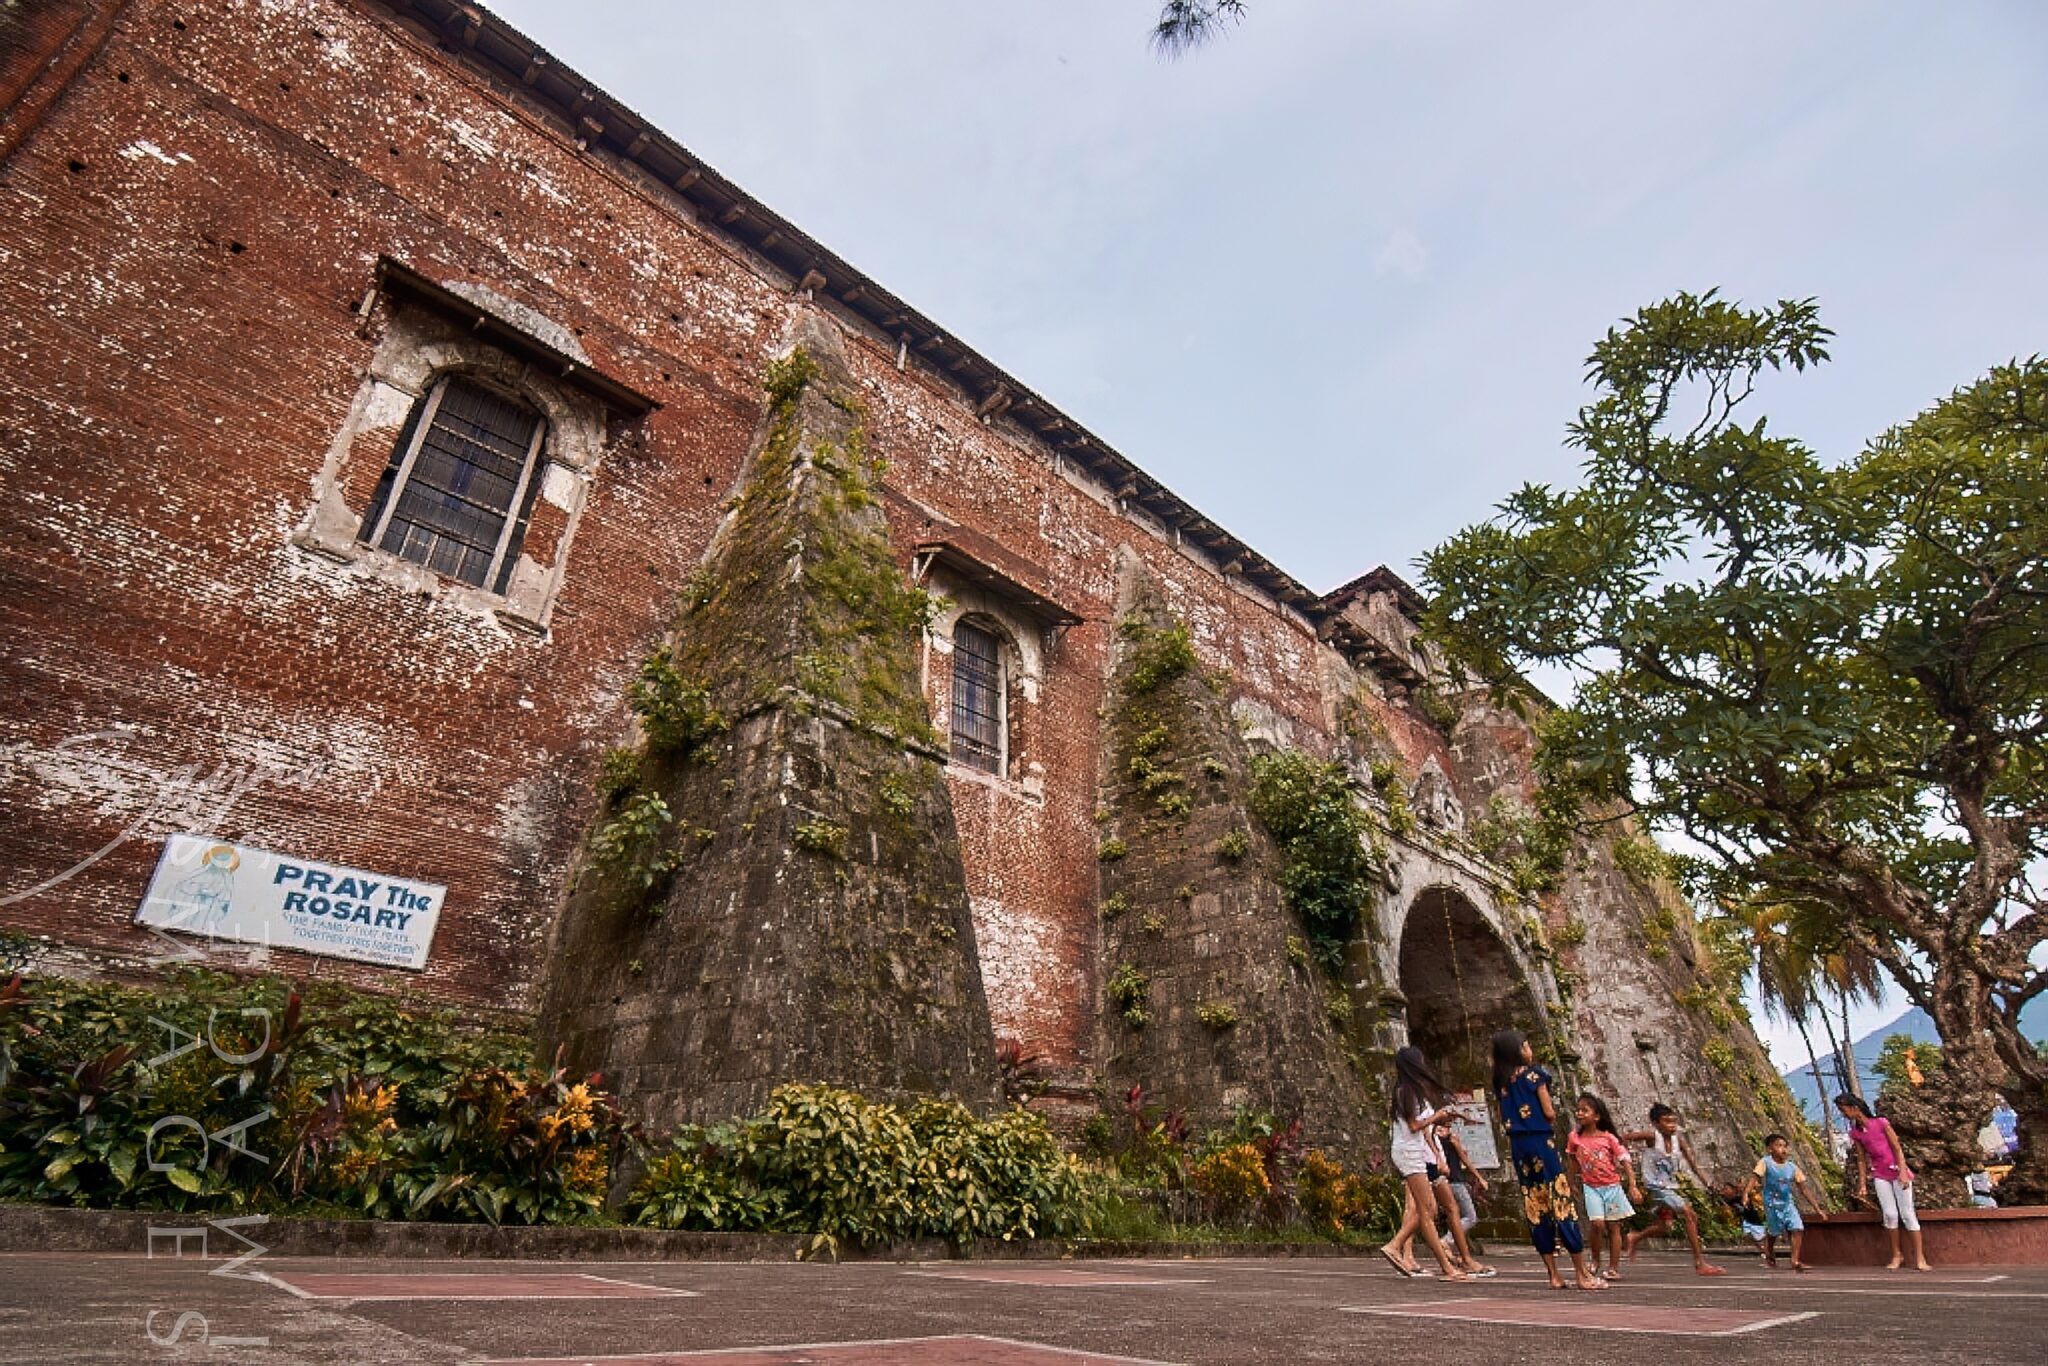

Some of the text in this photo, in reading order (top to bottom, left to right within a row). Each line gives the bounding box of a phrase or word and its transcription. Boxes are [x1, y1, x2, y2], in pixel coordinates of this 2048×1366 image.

[273, 864, 432, 911] PRAY The
[283, 892, 412, 930] ROSARY
